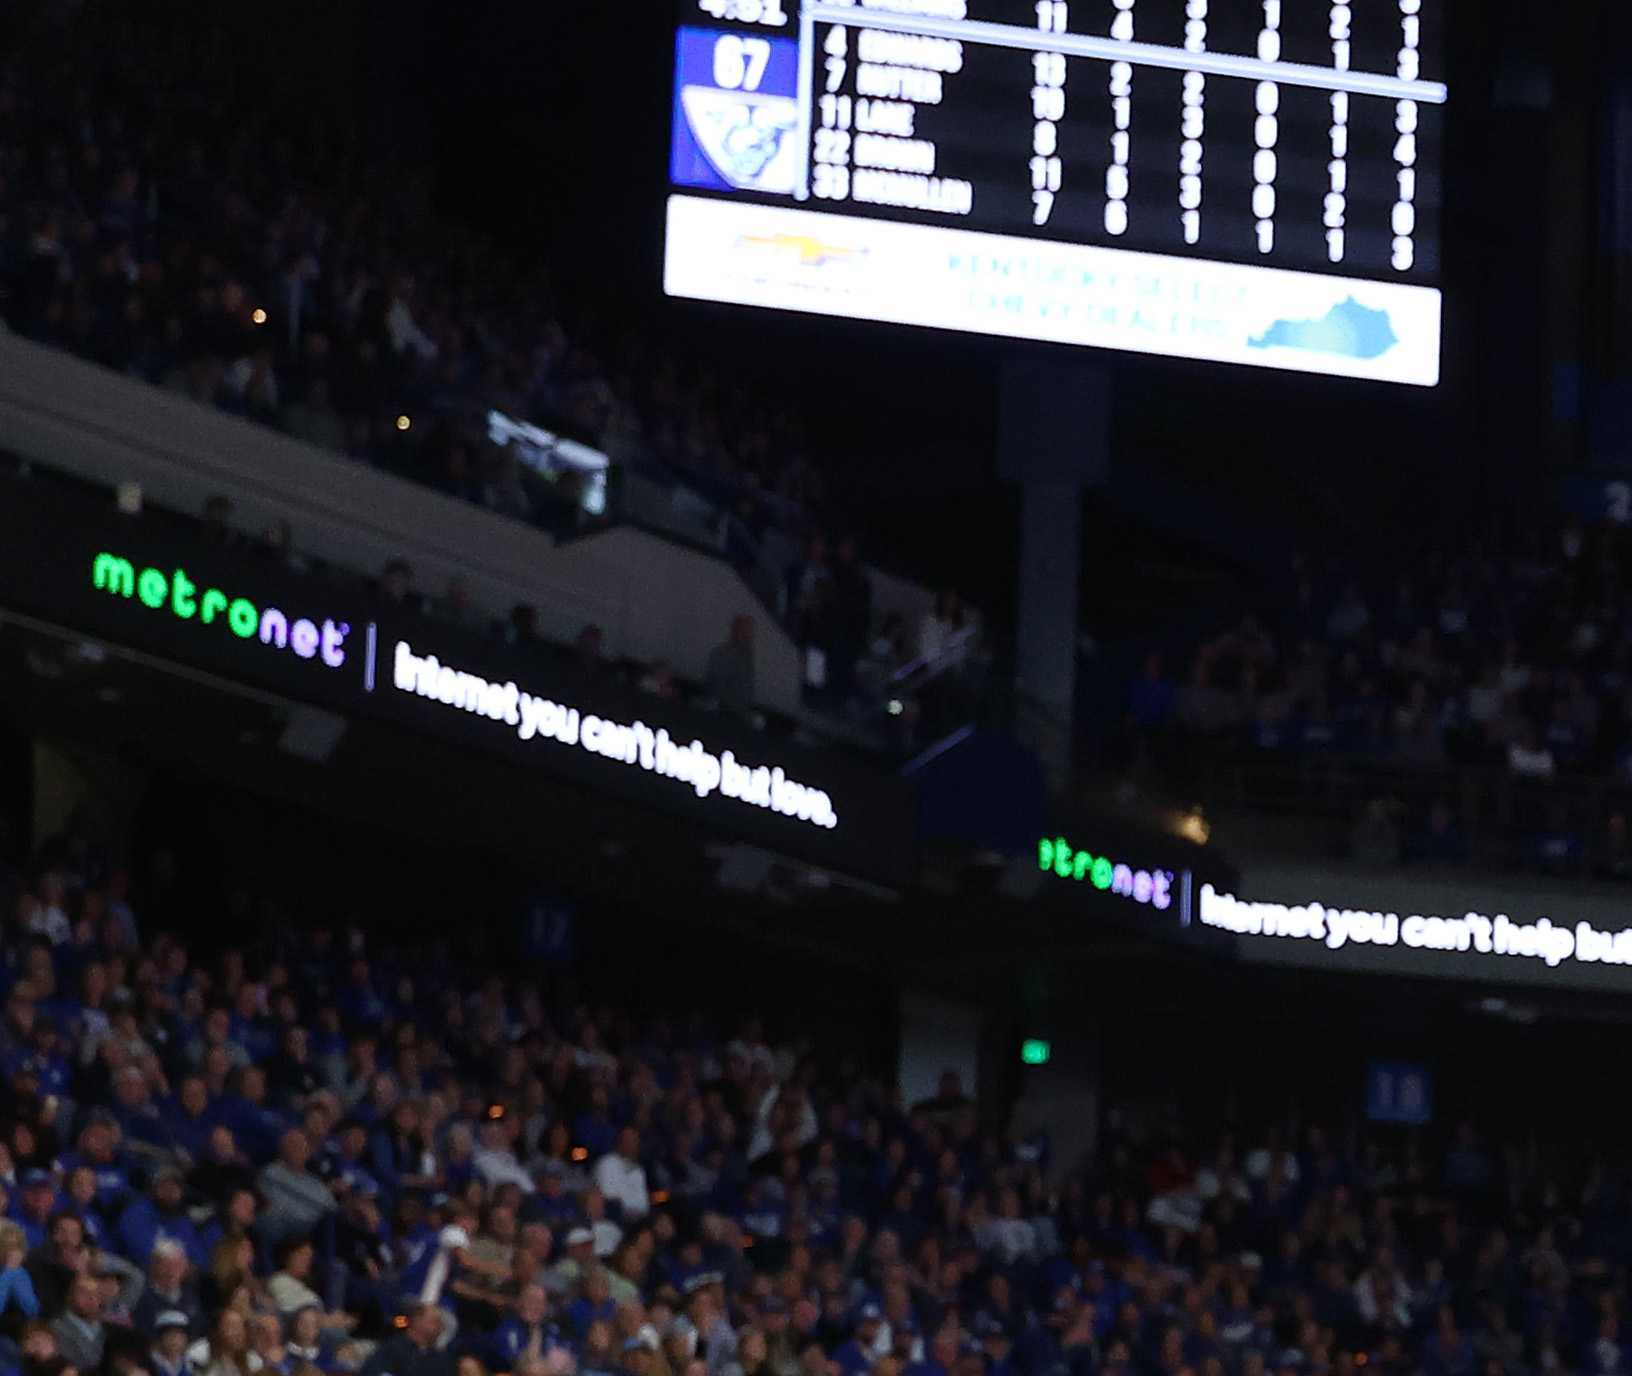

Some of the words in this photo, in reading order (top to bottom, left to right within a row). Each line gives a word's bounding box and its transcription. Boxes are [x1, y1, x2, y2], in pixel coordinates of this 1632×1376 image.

[92, 551, 347, 668] metronet
[519, 690, 579, 740] you
[1325, 908, 1398, 950] you
[1493, 914, 1575, 966] help
